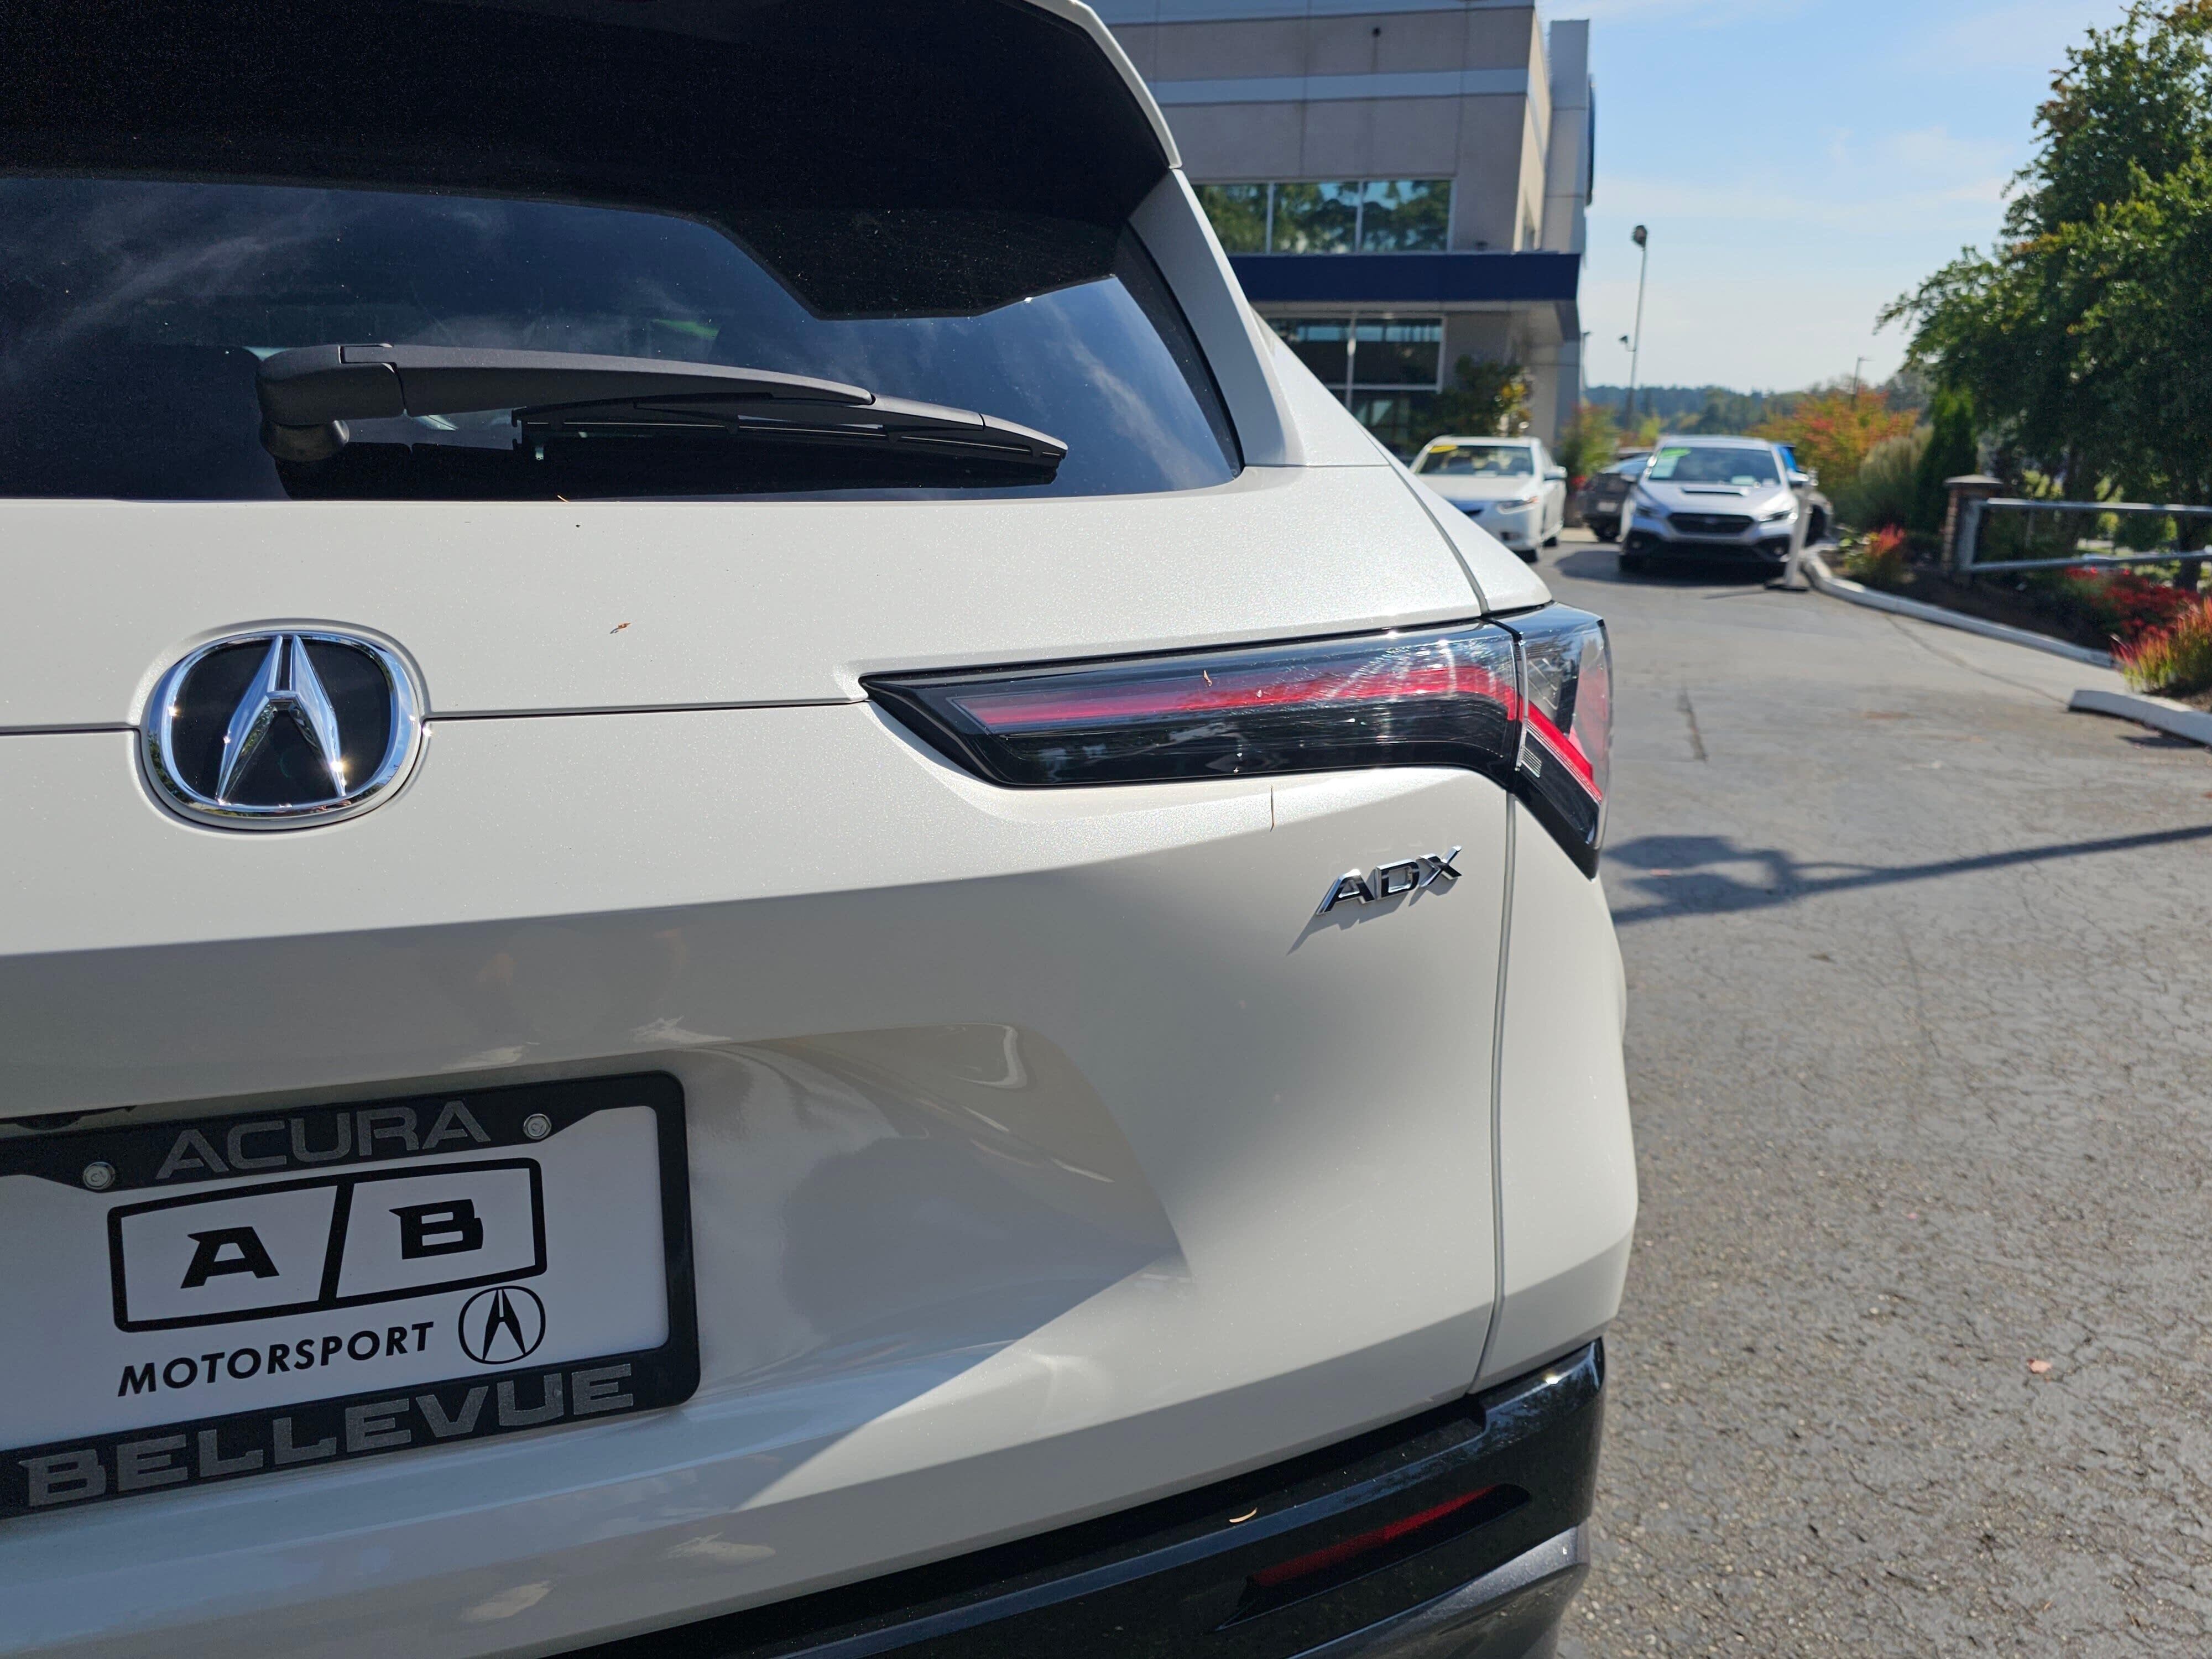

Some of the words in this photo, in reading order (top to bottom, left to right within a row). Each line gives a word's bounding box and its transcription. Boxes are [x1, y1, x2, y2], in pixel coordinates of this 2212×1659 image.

[1316, 844, 1463, 916] ADX
[155, 1100, 491, 1180] ACURA
[180, 1226, 280, 1289] A
[389, 1198, 484, 1260] B
[117, 1321, 434, 1397] MOTORSPORT
[18, 1364, 634, 1506] BELLEVUE
